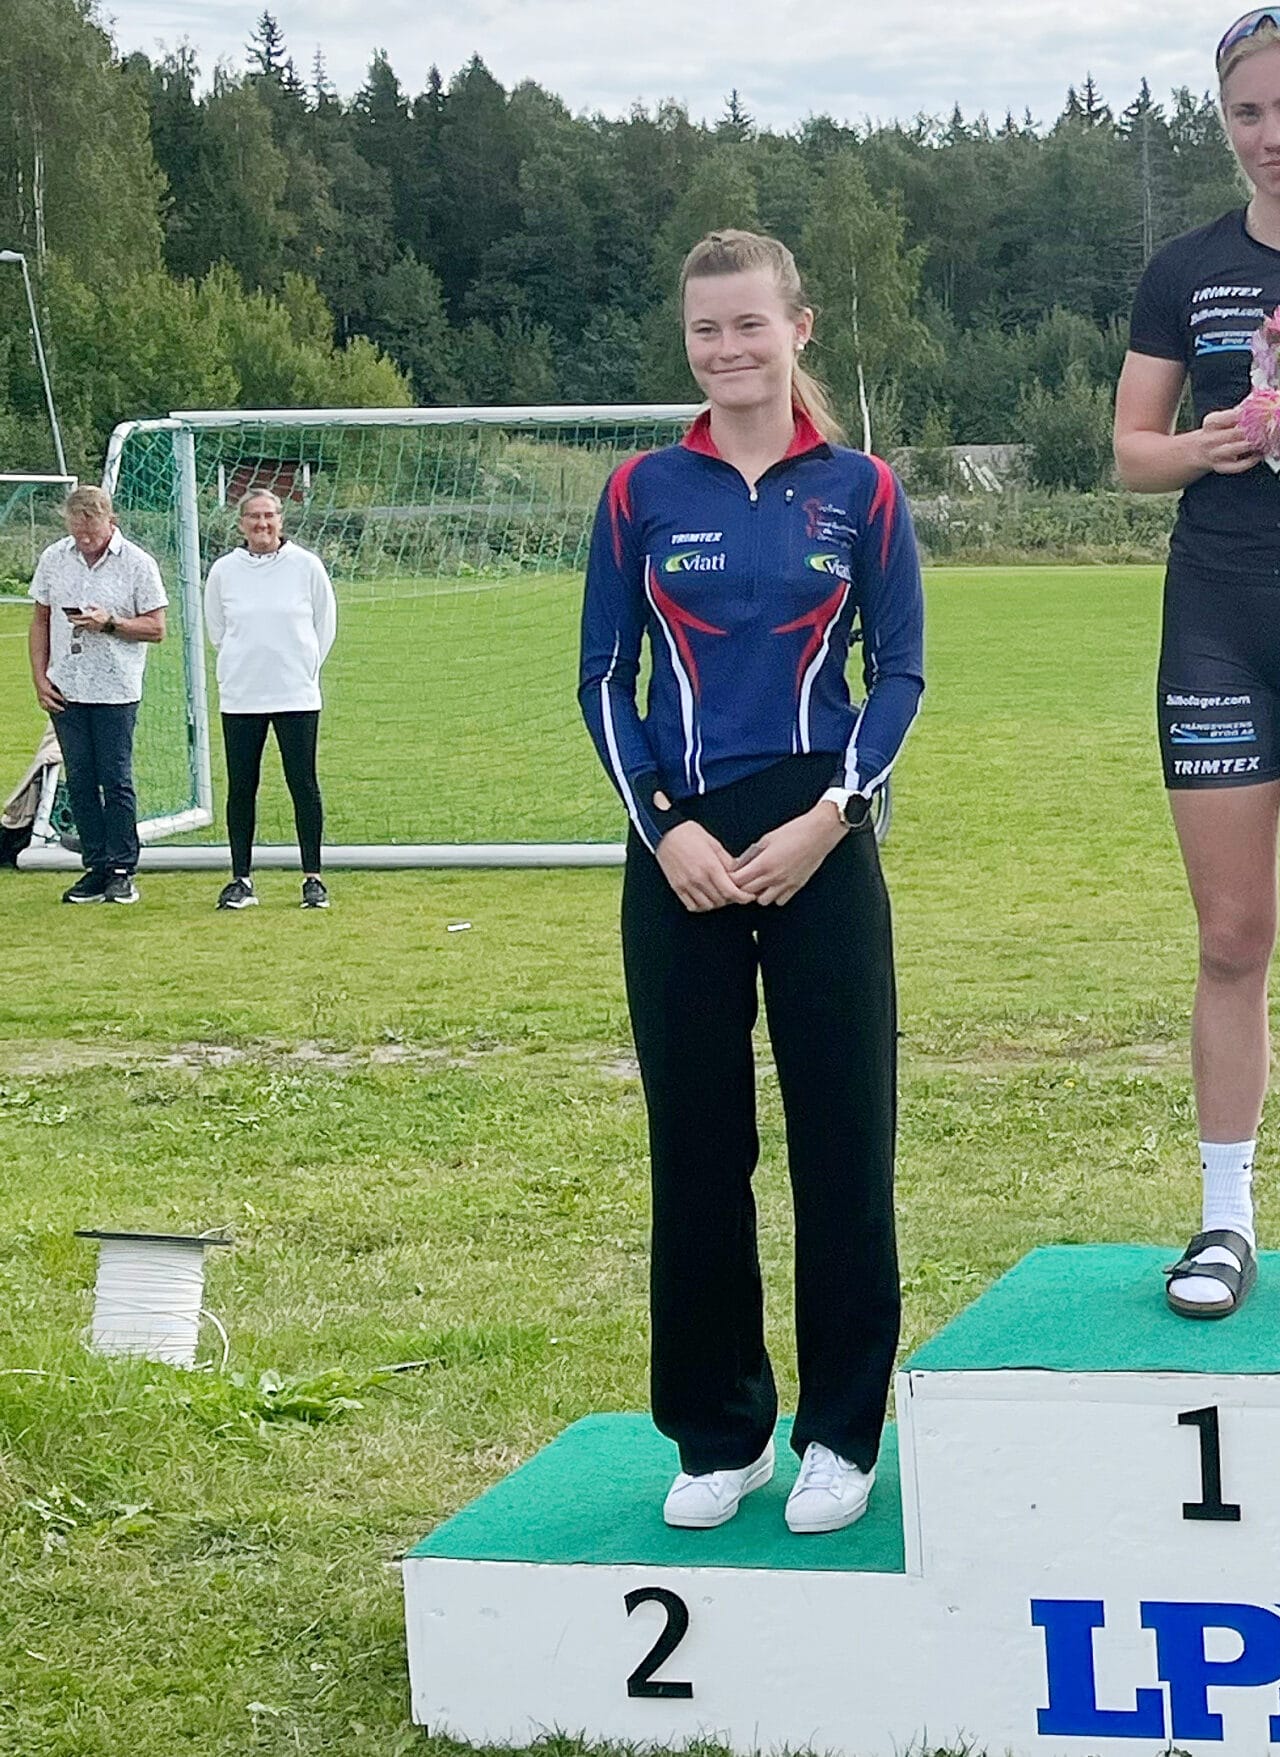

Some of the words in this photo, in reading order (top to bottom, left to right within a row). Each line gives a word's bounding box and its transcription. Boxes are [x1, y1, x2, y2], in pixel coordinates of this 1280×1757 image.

[1192, 286, 1262, 303] TRIMTEX
[672, 532, 723, 545] TRIMTEX
[1174, 757, 1260, 775] TRIMTEX
[1178, 1405, 1241, 1521] 1
[624, 1587, 693, 1698] 2
